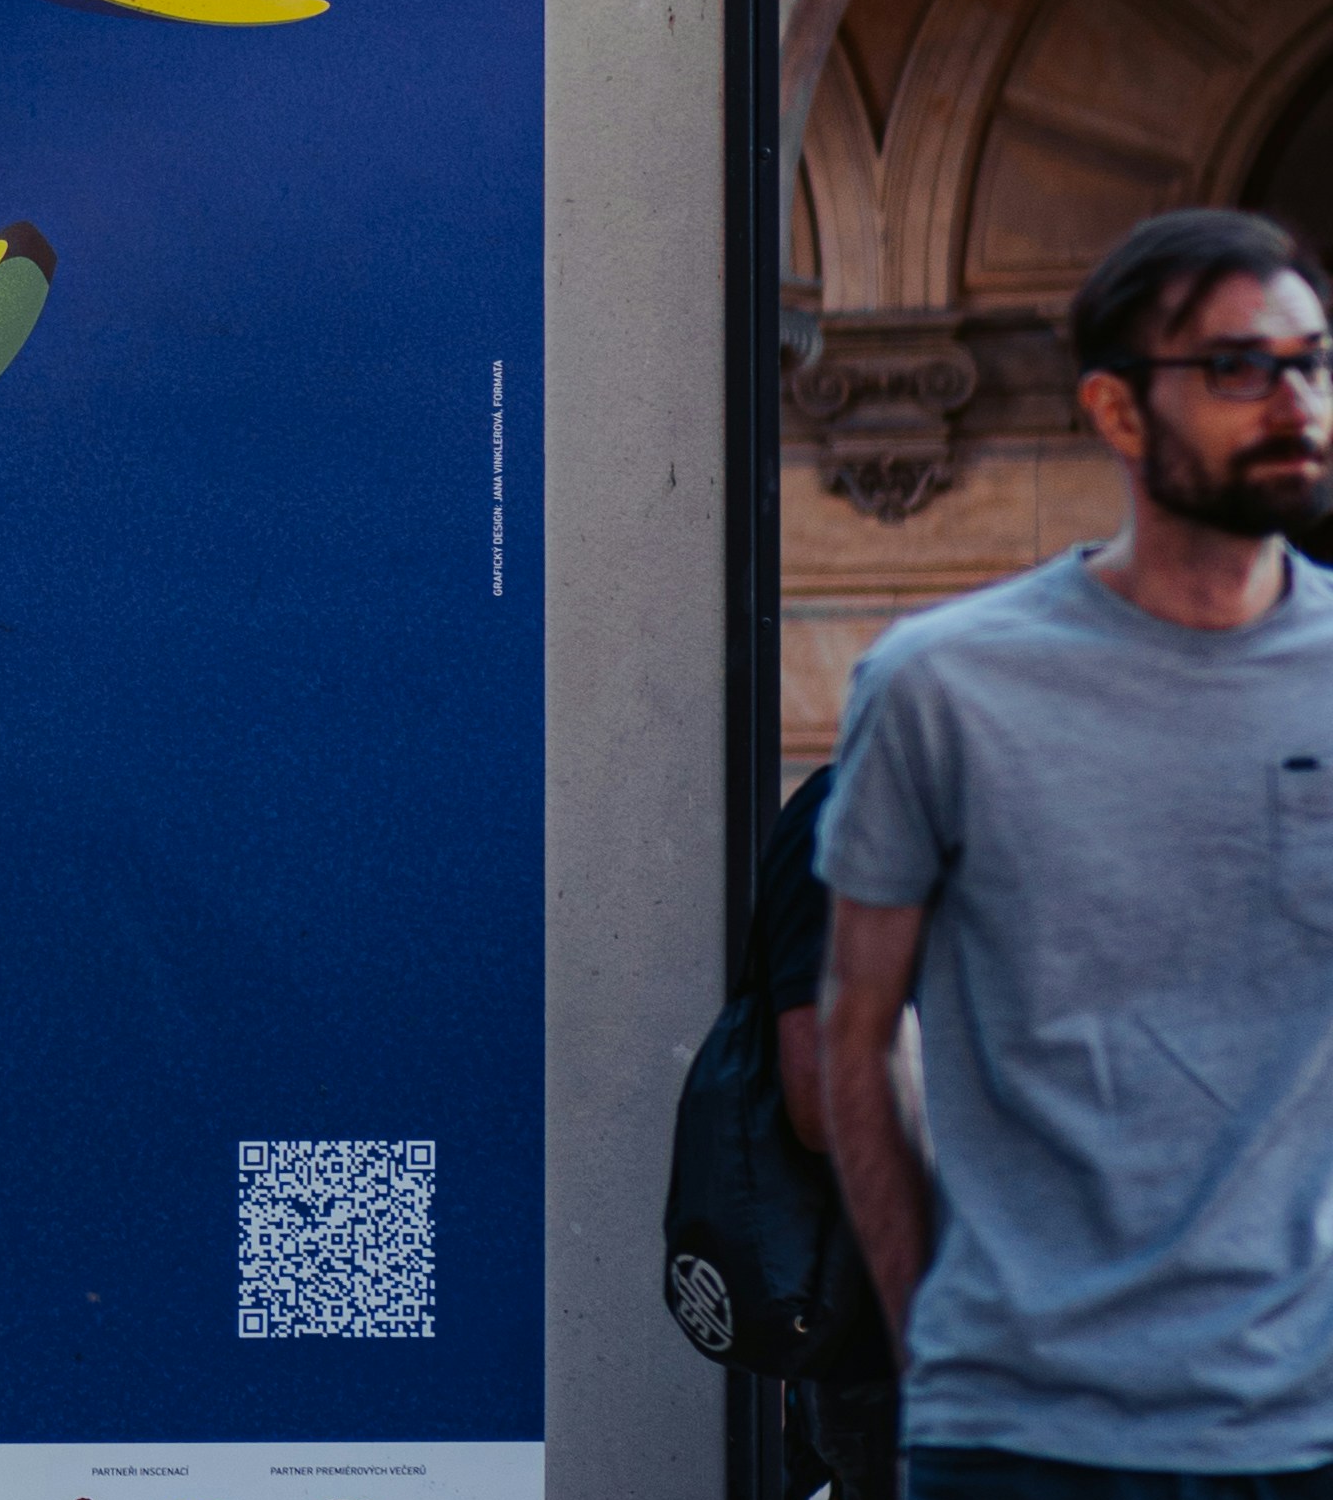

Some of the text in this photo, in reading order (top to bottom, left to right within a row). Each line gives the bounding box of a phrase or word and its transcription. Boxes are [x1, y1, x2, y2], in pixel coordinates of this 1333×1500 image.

[493, 360, 503, 407] FORMATA
[493, 476, 503, 502] JANA
[493, 505, 503, 544] DESIGN:
[492, 547, 503, 596] GRAFICKÝ
[91, 1465, 189, 1477] PARTNEŘI INSCENACÍ
[269, 1464, 427, 1476] PARTNER PREMIÉROVÝCH VEČERŮ
